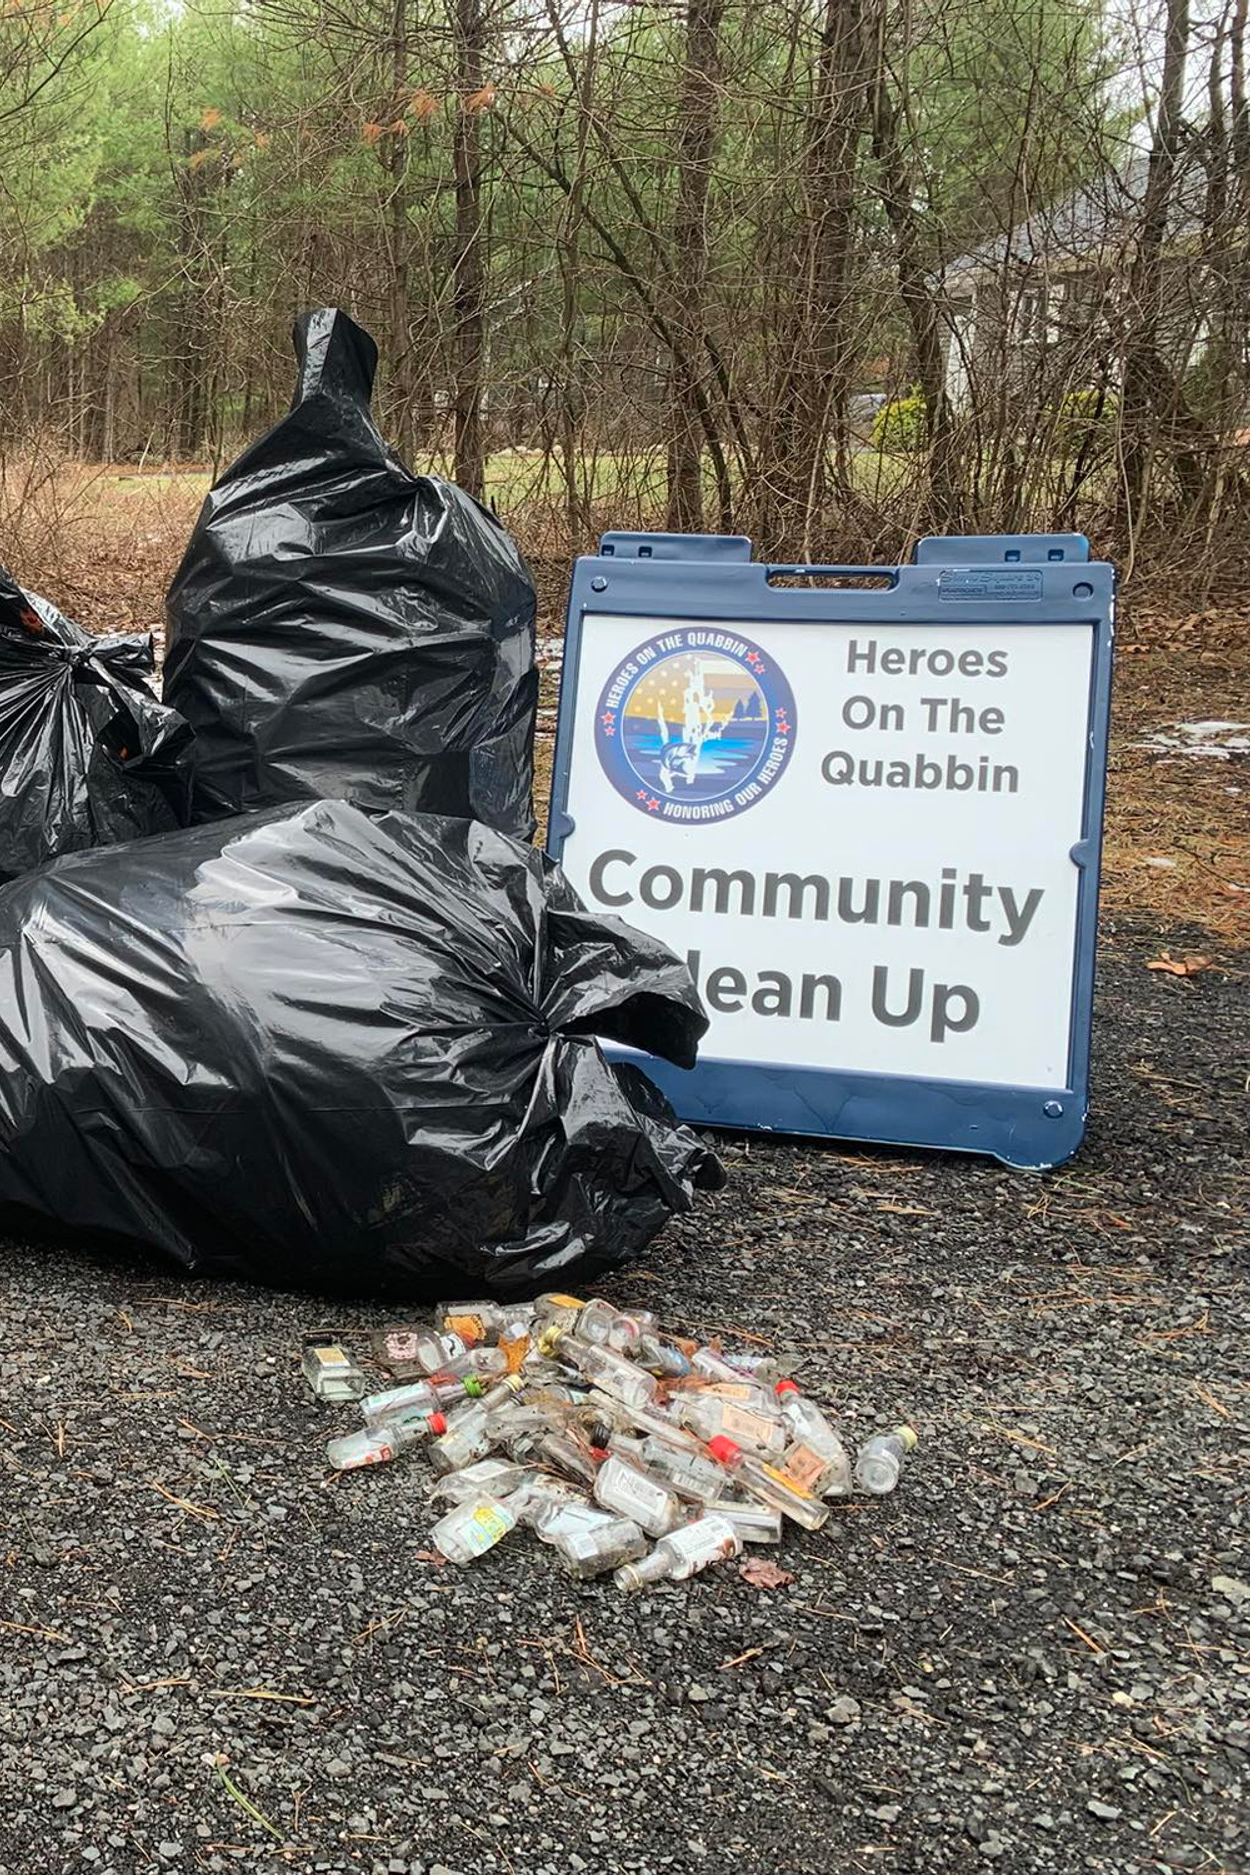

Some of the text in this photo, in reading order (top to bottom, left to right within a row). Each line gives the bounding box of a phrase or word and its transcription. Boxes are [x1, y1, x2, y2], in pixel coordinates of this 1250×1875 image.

[606, 632, 748, 708] HEROES ON THE QUABBIN
[847, 640, 1008, 678] Heroes
[842, 695, 1005, 735] On The
[663, 737, 788, 819] HONORING OUR HEROES
[821, 750, 1018, 793] Quabbin
[588, 849, 1046, 947] Community
[686, 949, 980, 1043] lean Up
